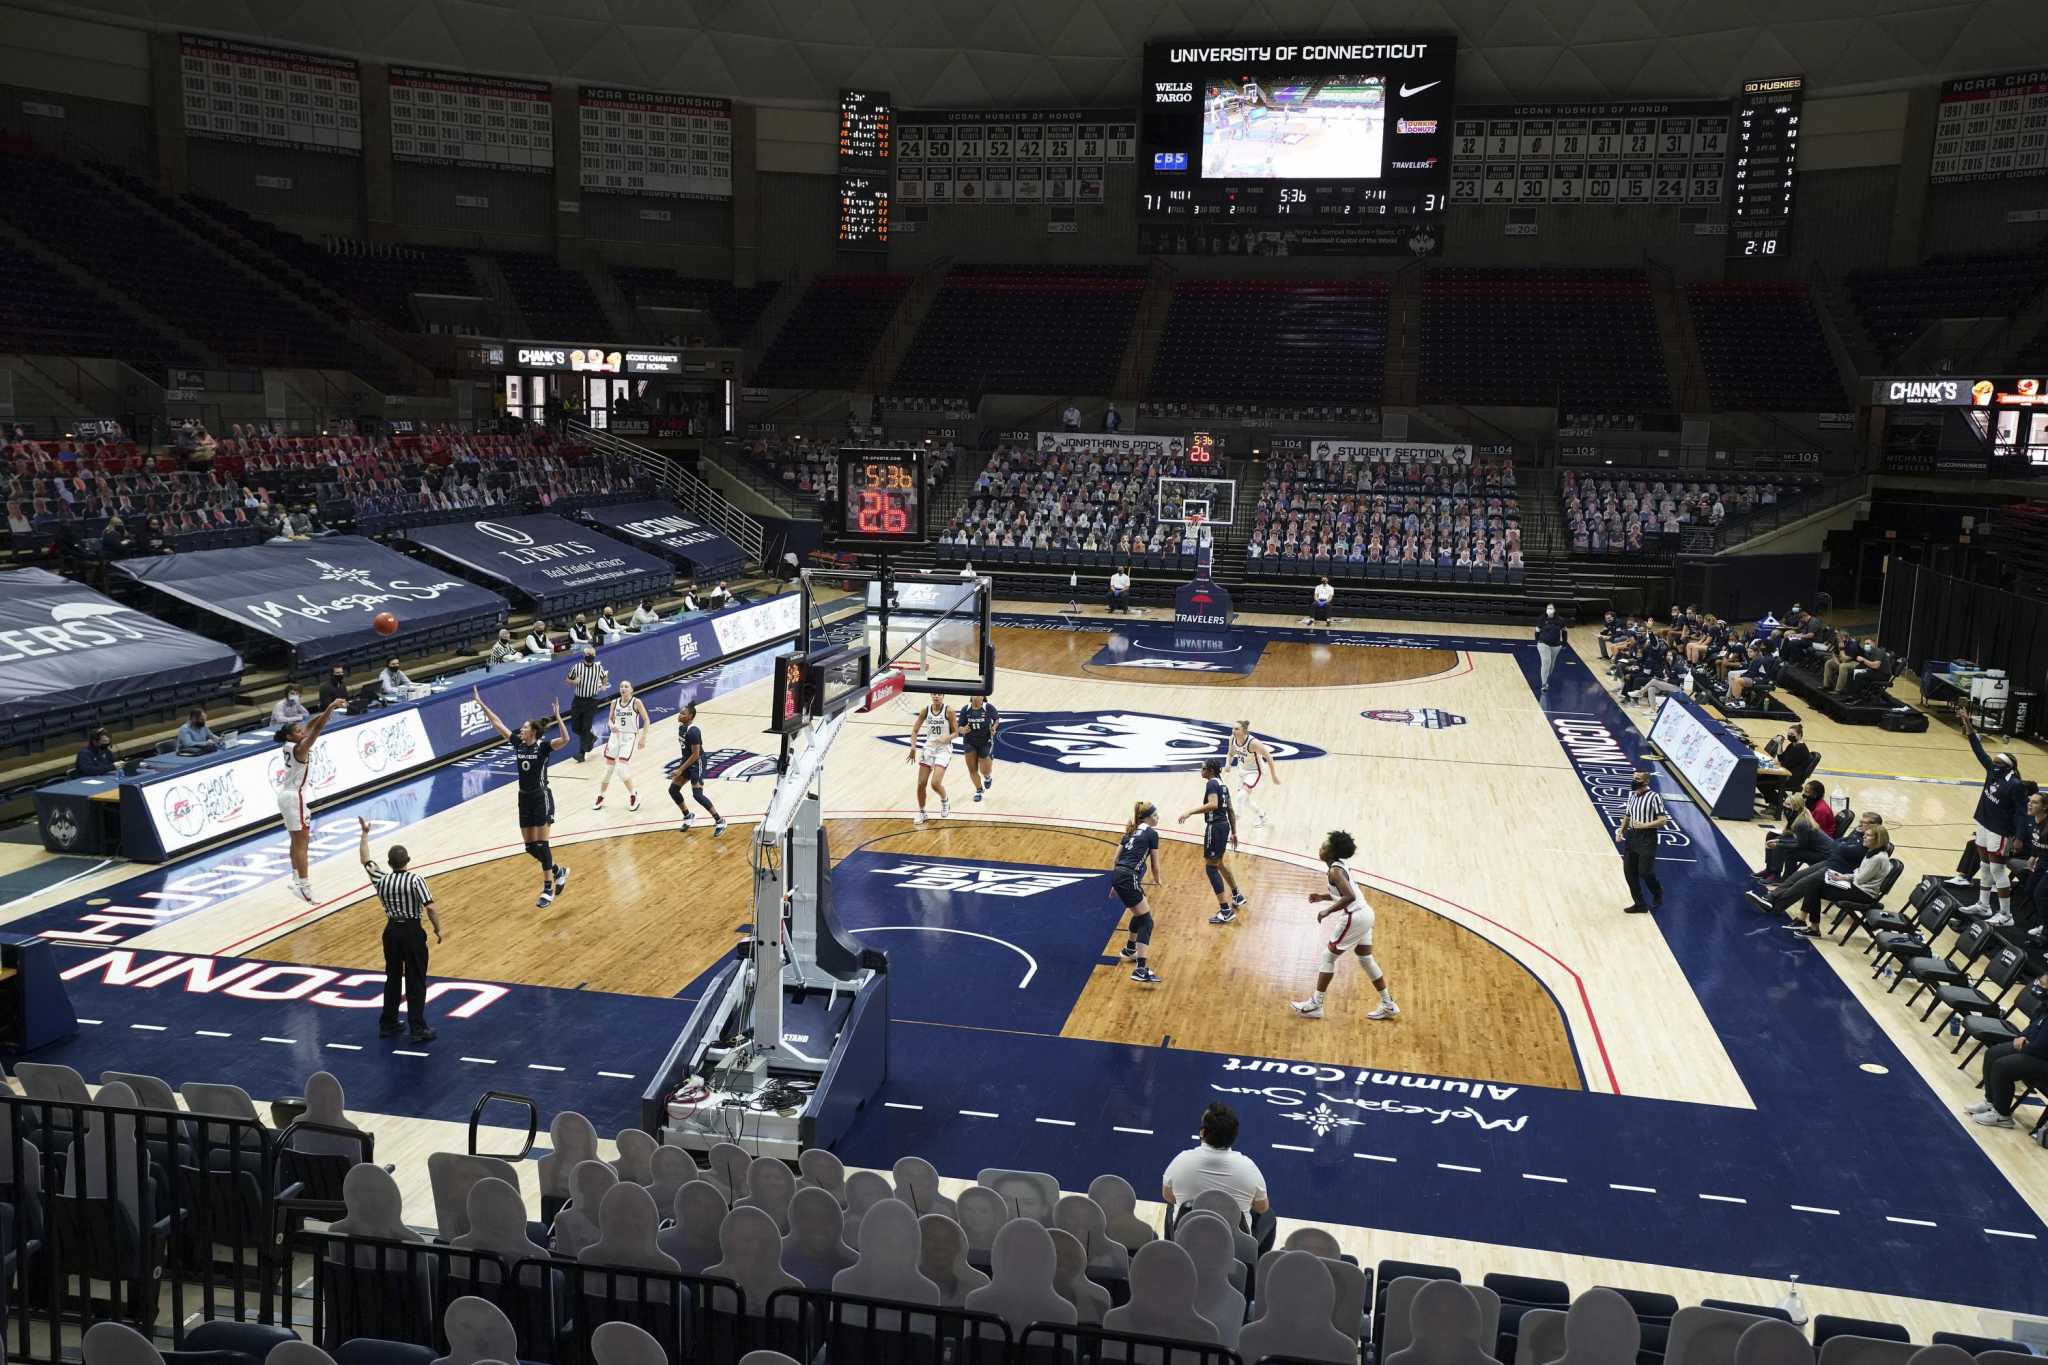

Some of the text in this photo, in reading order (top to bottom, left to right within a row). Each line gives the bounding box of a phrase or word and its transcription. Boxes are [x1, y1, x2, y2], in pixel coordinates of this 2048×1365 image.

[1170, 45, 1427, 63] UNIVERSITY OF CONNECTICUT
[1155, 82, 1193, 92] WELLS
[1745, 80, 1801, 91] GO HUSKIES
[1953, 79, 1996, 91] NCAA
[588, 89, 723, 107] NCAA CHAMPIONSHIP
[1155, 93, 1192, 102] FARGO
[948, 113, 980, 121] UCONN
[985, 112, 1026, 120] HUSKIES
[1514, 105, 1669, 115] UCONN HUSKIES OF HONOR
[901, 143, 920, 156] 24
[930, 142, 949, 156] 50
[962, 142, 977, 156] 21
[991, 142, 1009, 156] 52
[1020, 142, 1040, 156] 42
[1052, 141, 1067, 156] 25
[1084, 141, 1097, 155] 33
[1463, 138, 1476, 153] 32
[1599, 136, 1611, 153] 31
[1632, 136, 1646, 152] 23
[1666, 135, 1682, 151] 31
[1702, 135, 1717, 151] 14
[1392, 161, 1431, 169] TRAVELERS
[1456, 180, 1718, 196] 23 4 30 3 15 24 33
[1144, 194, 1160, 210] 71
[1425, 194, 1445, 211] 31
[1744, 240, 1776, 255] 2:18
[518, 349, 565, 364] CHANK'S
[1890, 382, 1958, 400] CHANK'S
[1060, 438, 1164, 452] JONATHAN'S PACK
[1338, 446, 1445, 458] STUDENT SECTION
[616, 515, 701, 538] UCONN
[661, 530, 719, 548] HEALTH
[498, 540, 596, 565] LEWIS
[542, 566, 565, 579] Real
[247, 579, 465, 628] Mohegan Sun
[1176, 614, 1225, 624] TRAVELERS
[678, 633, 692, 646] BIG
[680, 642, 698, 653] EAST
[460, 700, 482, 716] BIG
[620, 718, 626, 726] 5
[2016, 702, 2028, 734] TRASH
[931, 726, 942, 735] 20
[1553, 718, 1632, 765] UCONN
[522, 760, 531, 772] 0
[894, 876, 1055, 898] BIG
[60, 949, 512, 1018] UCONN
[1222, 1056, 1520, 1102] Alumni Court
[1210, 1082, 1530, 1133] Mohegan Sun
